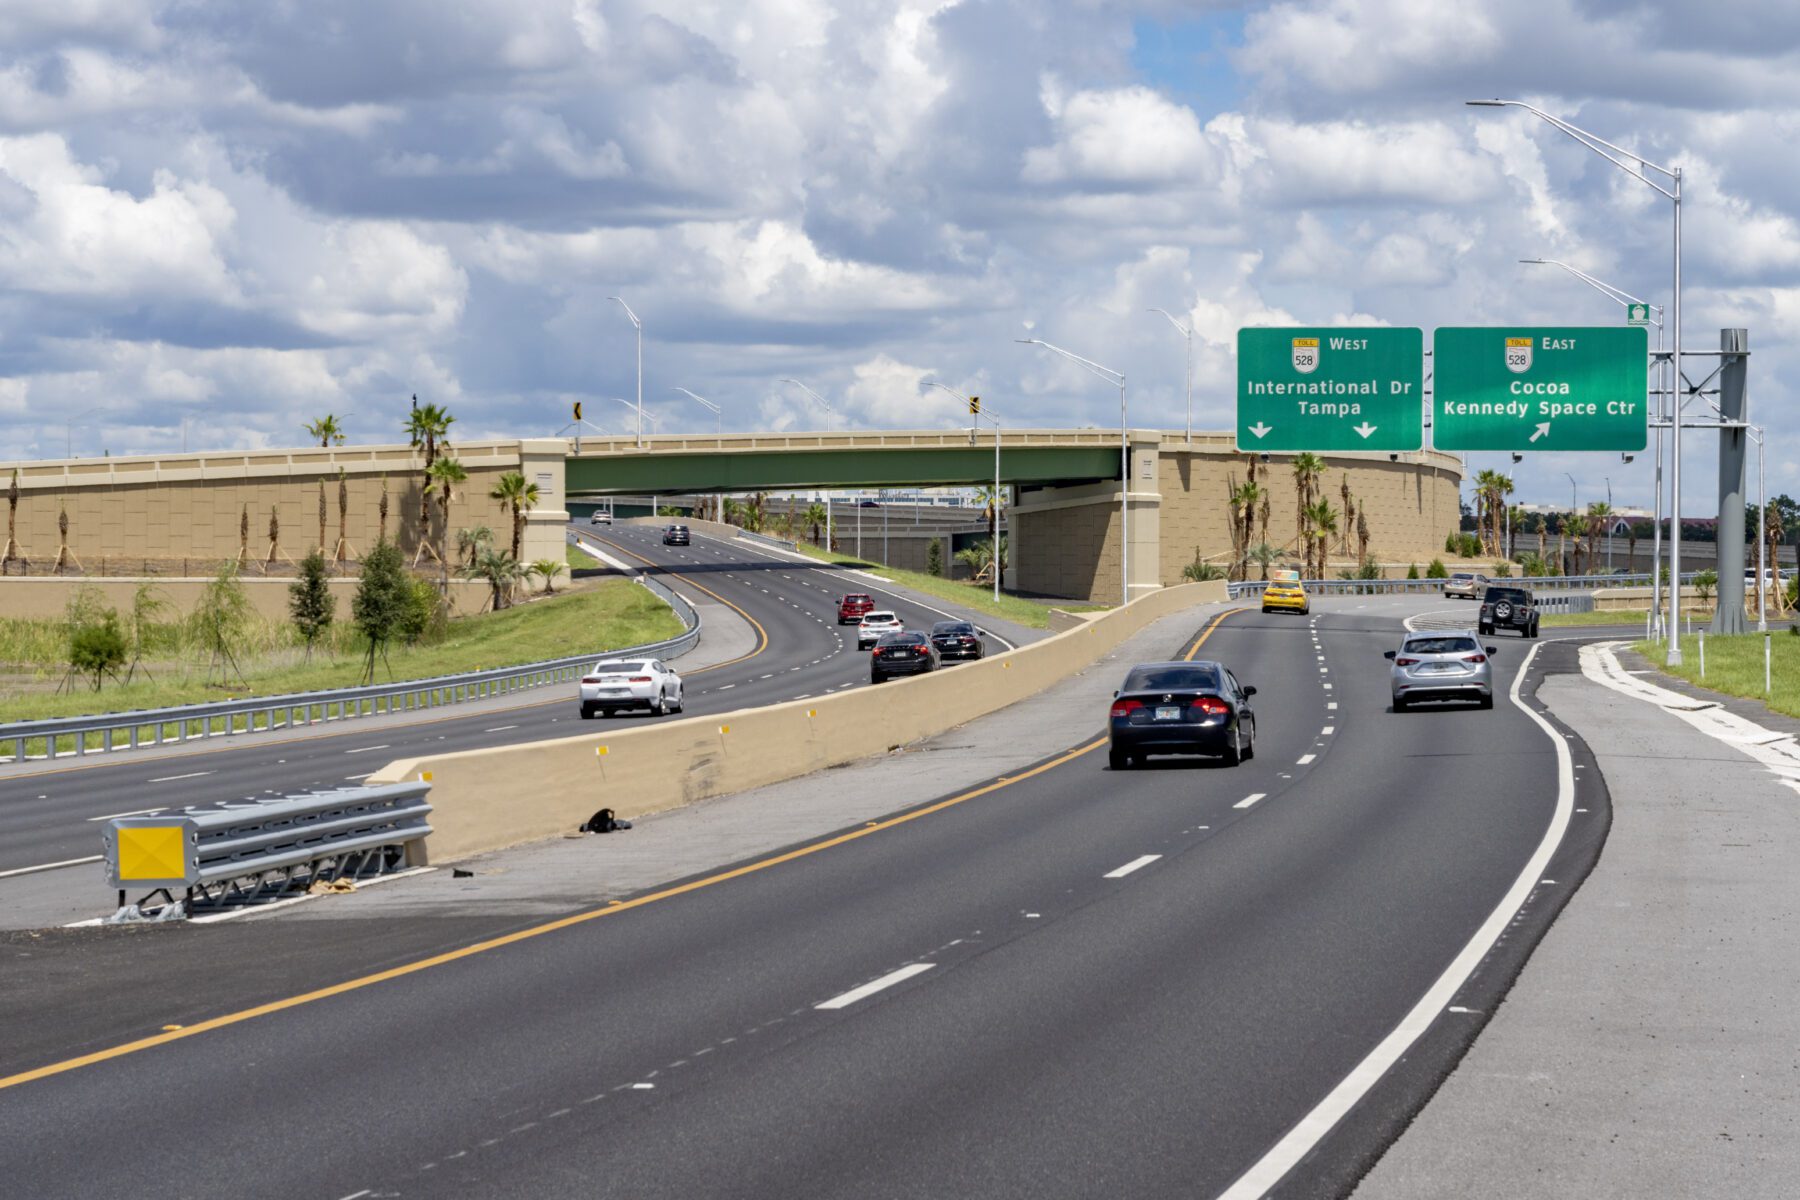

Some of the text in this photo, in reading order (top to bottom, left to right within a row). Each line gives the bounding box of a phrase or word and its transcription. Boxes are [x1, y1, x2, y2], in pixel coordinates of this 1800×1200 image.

[1329, 337, 1368, 350] WEST
[1542, 337, 1576, 350] EAST
[1295, 355, 1313, 366] 528
[1508, 354, 1527, 366] 528
[1248, 380, 1412, 395] International Dr
[1510, 381, 1570, 395] Cocoa
[1298, 401, 1361, 418] Tampa
[1444, 401, 1636, 418] Kennedy Space Ctr
